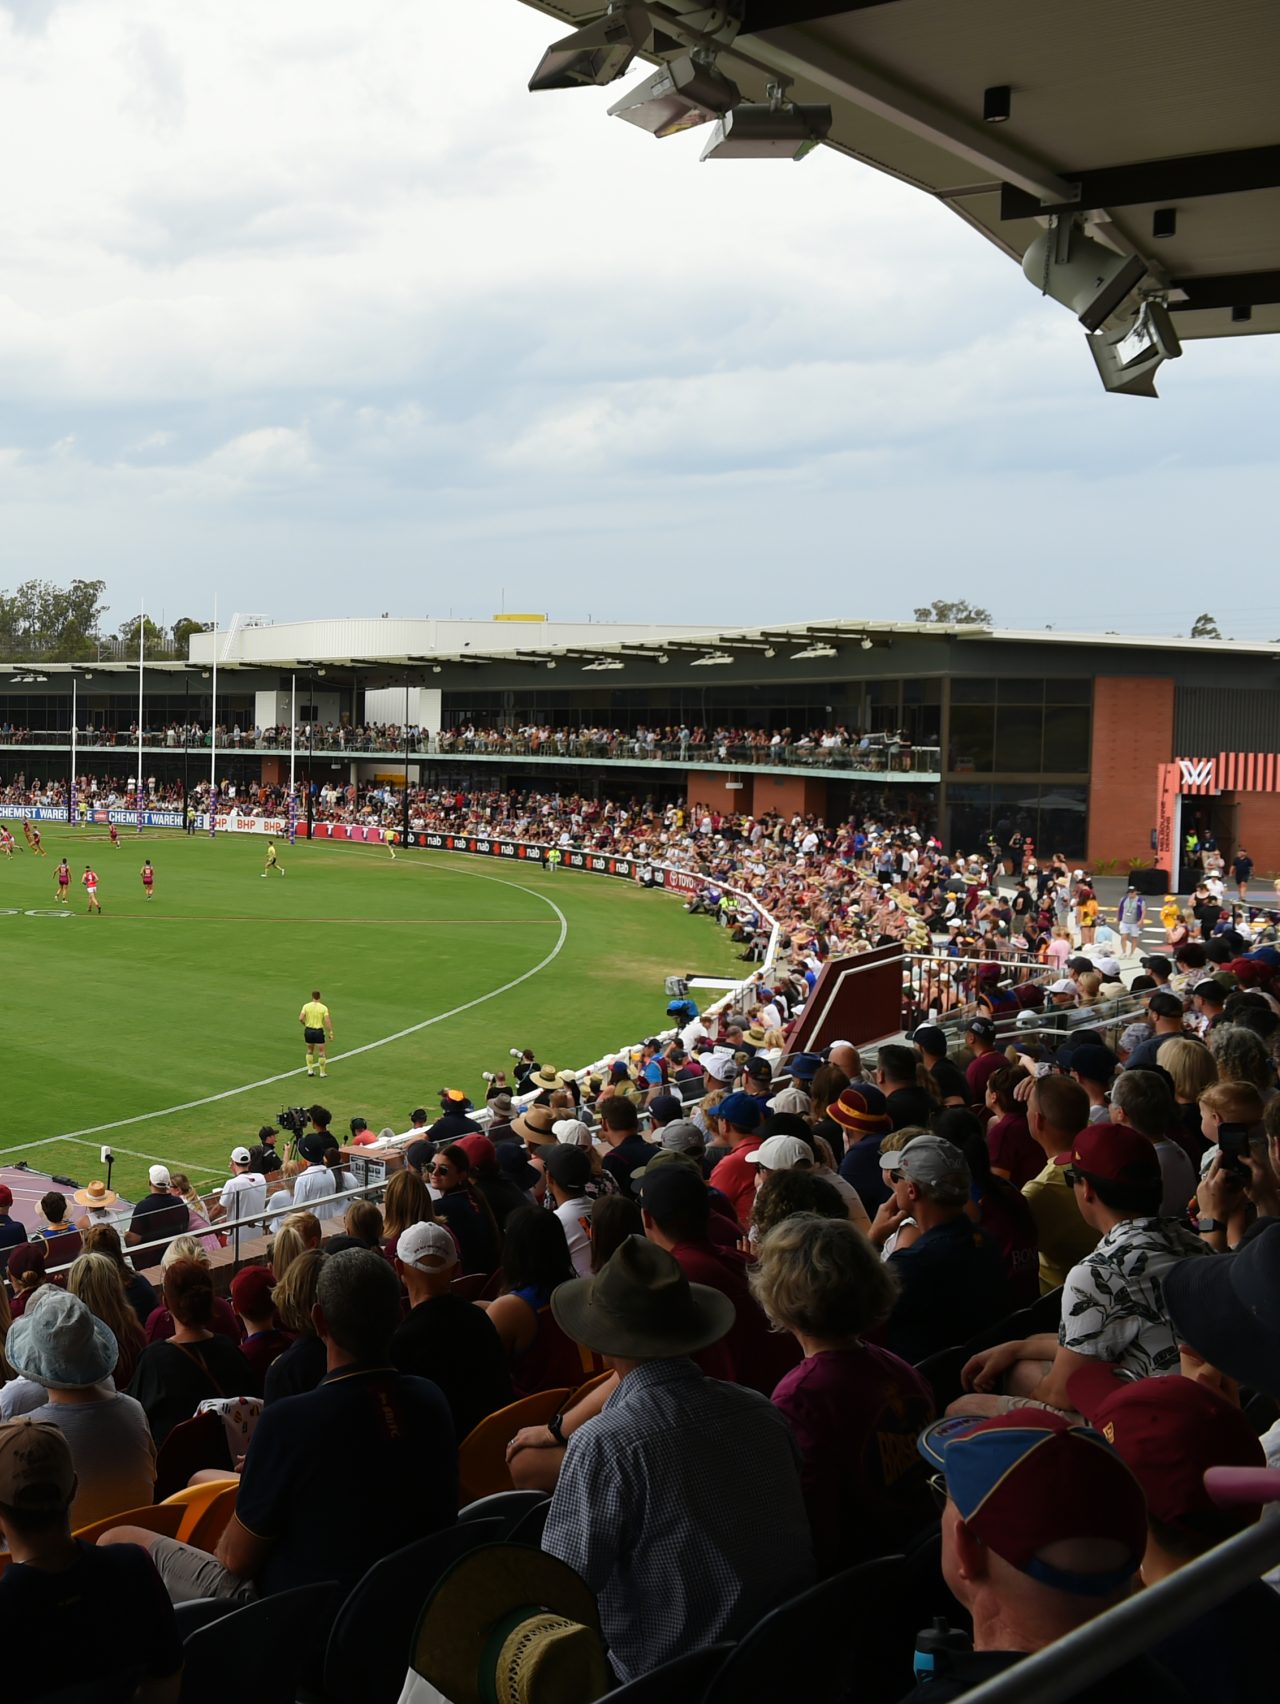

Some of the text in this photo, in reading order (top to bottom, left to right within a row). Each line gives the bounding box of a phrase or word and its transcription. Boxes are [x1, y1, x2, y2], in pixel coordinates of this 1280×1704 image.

[40, 809, 93, 821] WAREHUE
[109, 811, 149, 823] CHEMIT
[237, 820, 281, 831] BHP BHP
[428, 836, 441, 845] nab
[455, 838, 466, 848] nab
[477, 841, 489, 851] nab
[501, 844, 514, 855] nab
[527, 847, 540, 858] nab
[571, 854, 582, 865] nab
[593, 857, 605, 869] nab
[616, 861, 628, 873] nab
